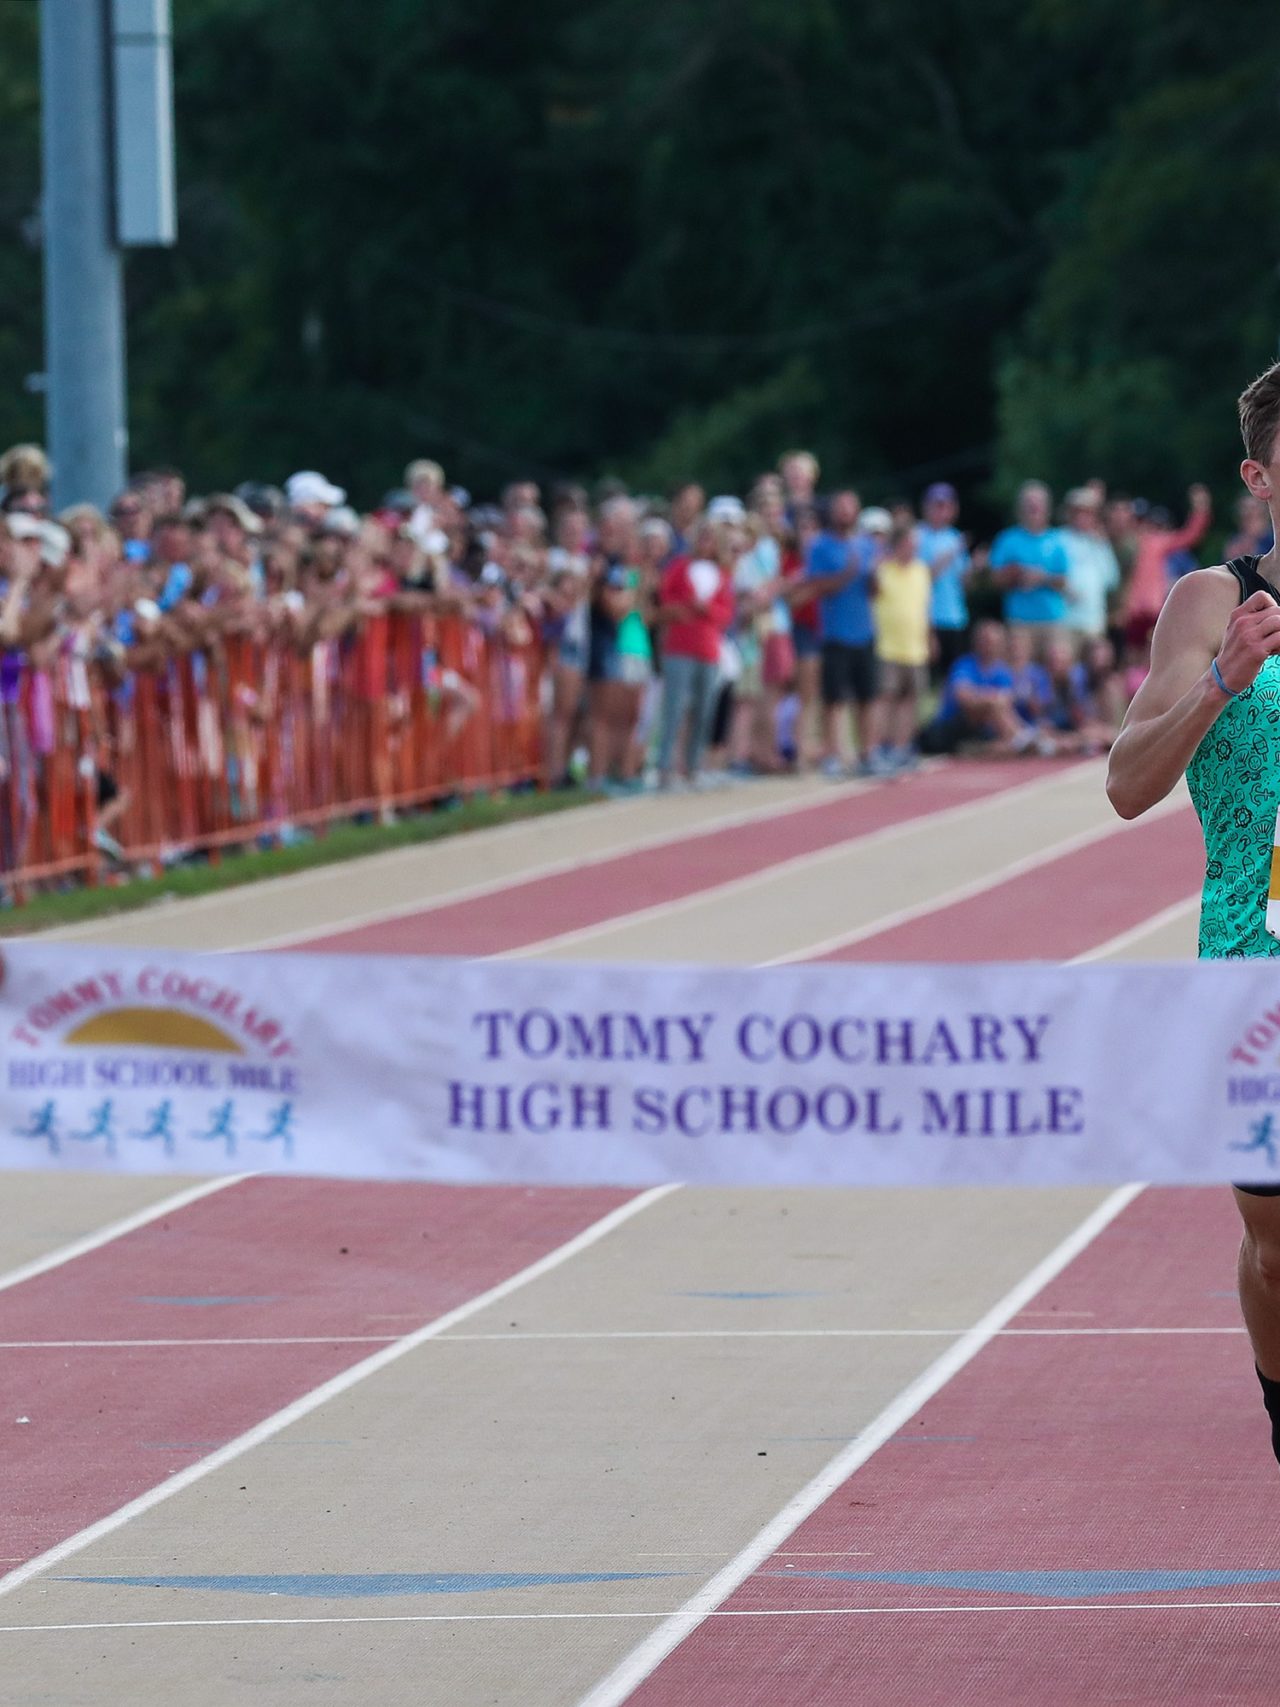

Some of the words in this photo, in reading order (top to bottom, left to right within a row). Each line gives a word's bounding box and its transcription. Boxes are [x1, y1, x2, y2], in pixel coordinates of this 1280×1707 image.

[11, 971, 122, 1046] TOMMY
[137, 966, 295, 1058] COCHARY
[472, 1008, 715, 1065] TOMMY
[736, 1012, 1052, 1066] COCHARY
[8, 1059, 85, 1088] HIGH
[95, 1059, 216, 1090] SCHOOL
[227, 1062, 298, 1092] MILE
[446, 1079, 611, 1134] HIGH
[632, 1082, 902, 1138] SCHOOL
[922, 1085, 1085, 1138] MILE
